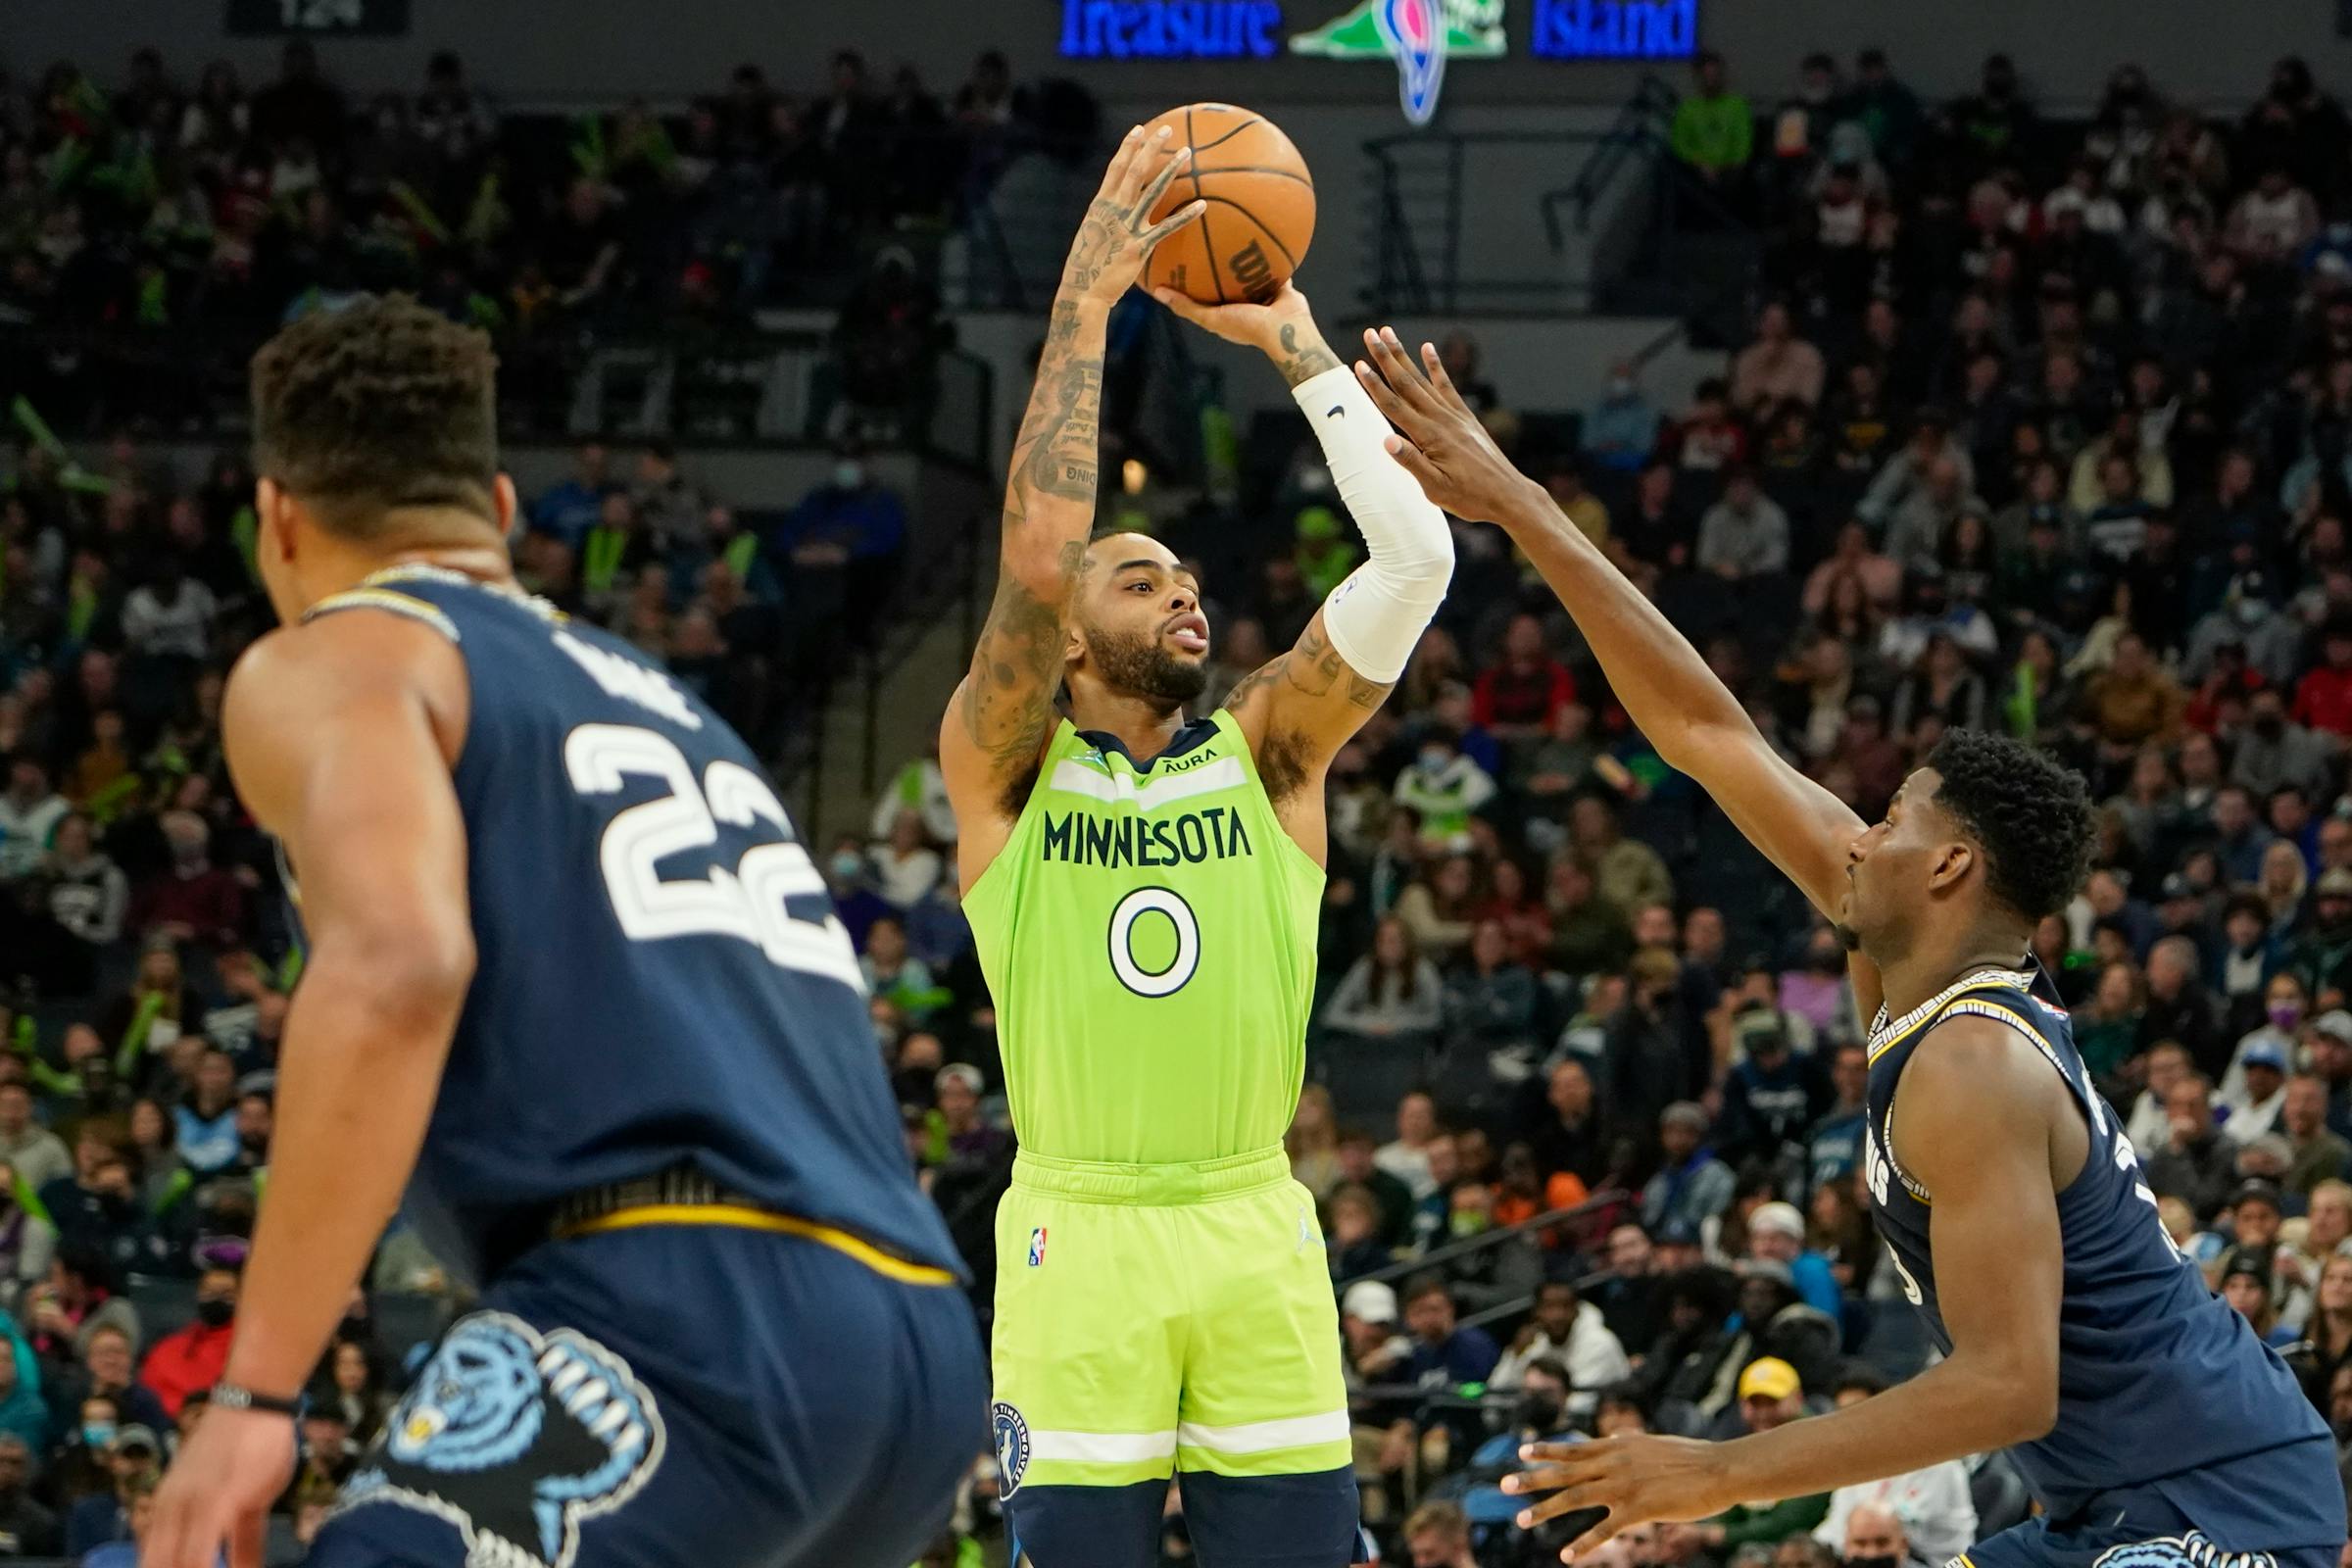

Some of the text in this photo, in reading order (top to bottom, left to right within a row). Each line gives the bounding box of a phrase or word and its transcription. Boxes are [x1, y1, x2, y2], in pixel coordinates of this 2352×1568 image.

[564, 722, 867, 999] 22
[1043, 806, 1252, 868] MINNESOTA
[1107, 886, 1200, 999] 0
